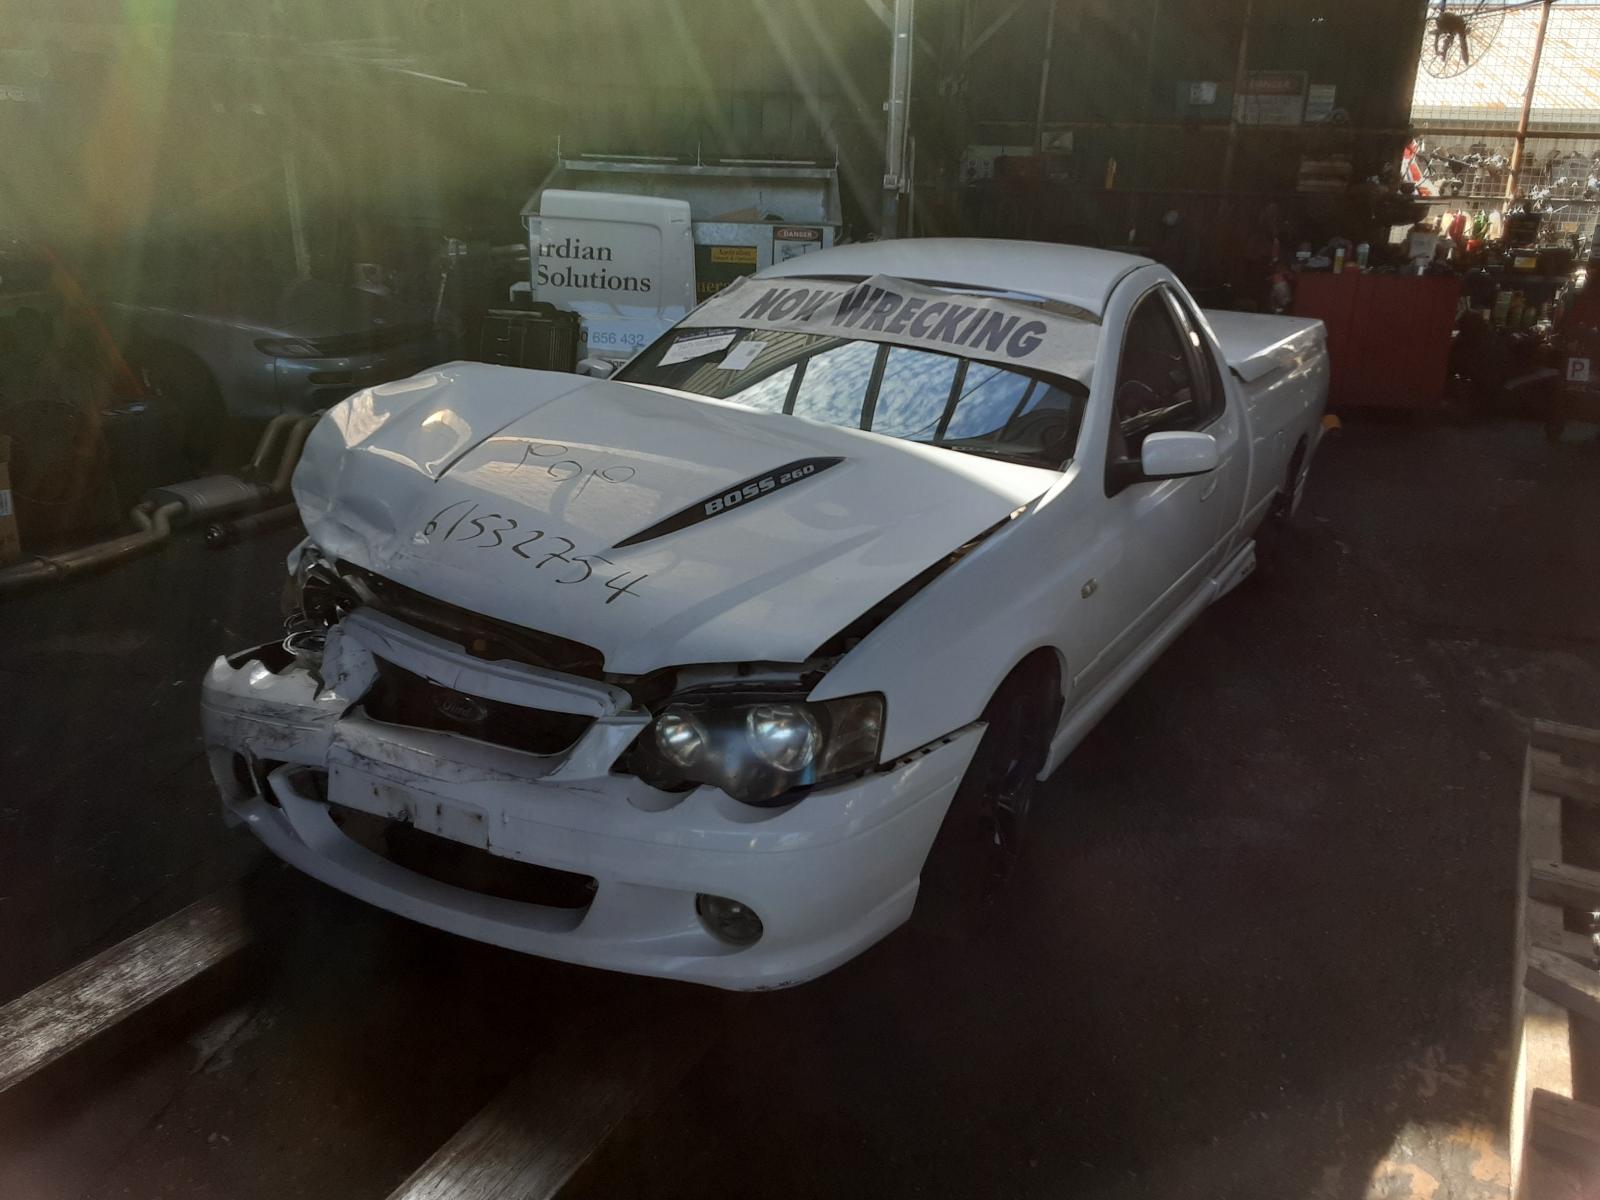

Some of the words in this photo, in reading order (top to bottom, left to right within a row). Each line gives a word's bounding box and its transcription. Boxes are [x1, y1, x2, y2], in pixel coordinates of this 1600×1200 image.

[783, 231, 813, 239] DANGER
[537, 264, 651, 293] Solutions
[832, 284, 1047, 358] WRECKING
[592, 331, 617, 345] 656
[620, 333, 645, 347] 432
[704, 476, 776, 516] BOSS
[780, 464, 815, 485] 260
